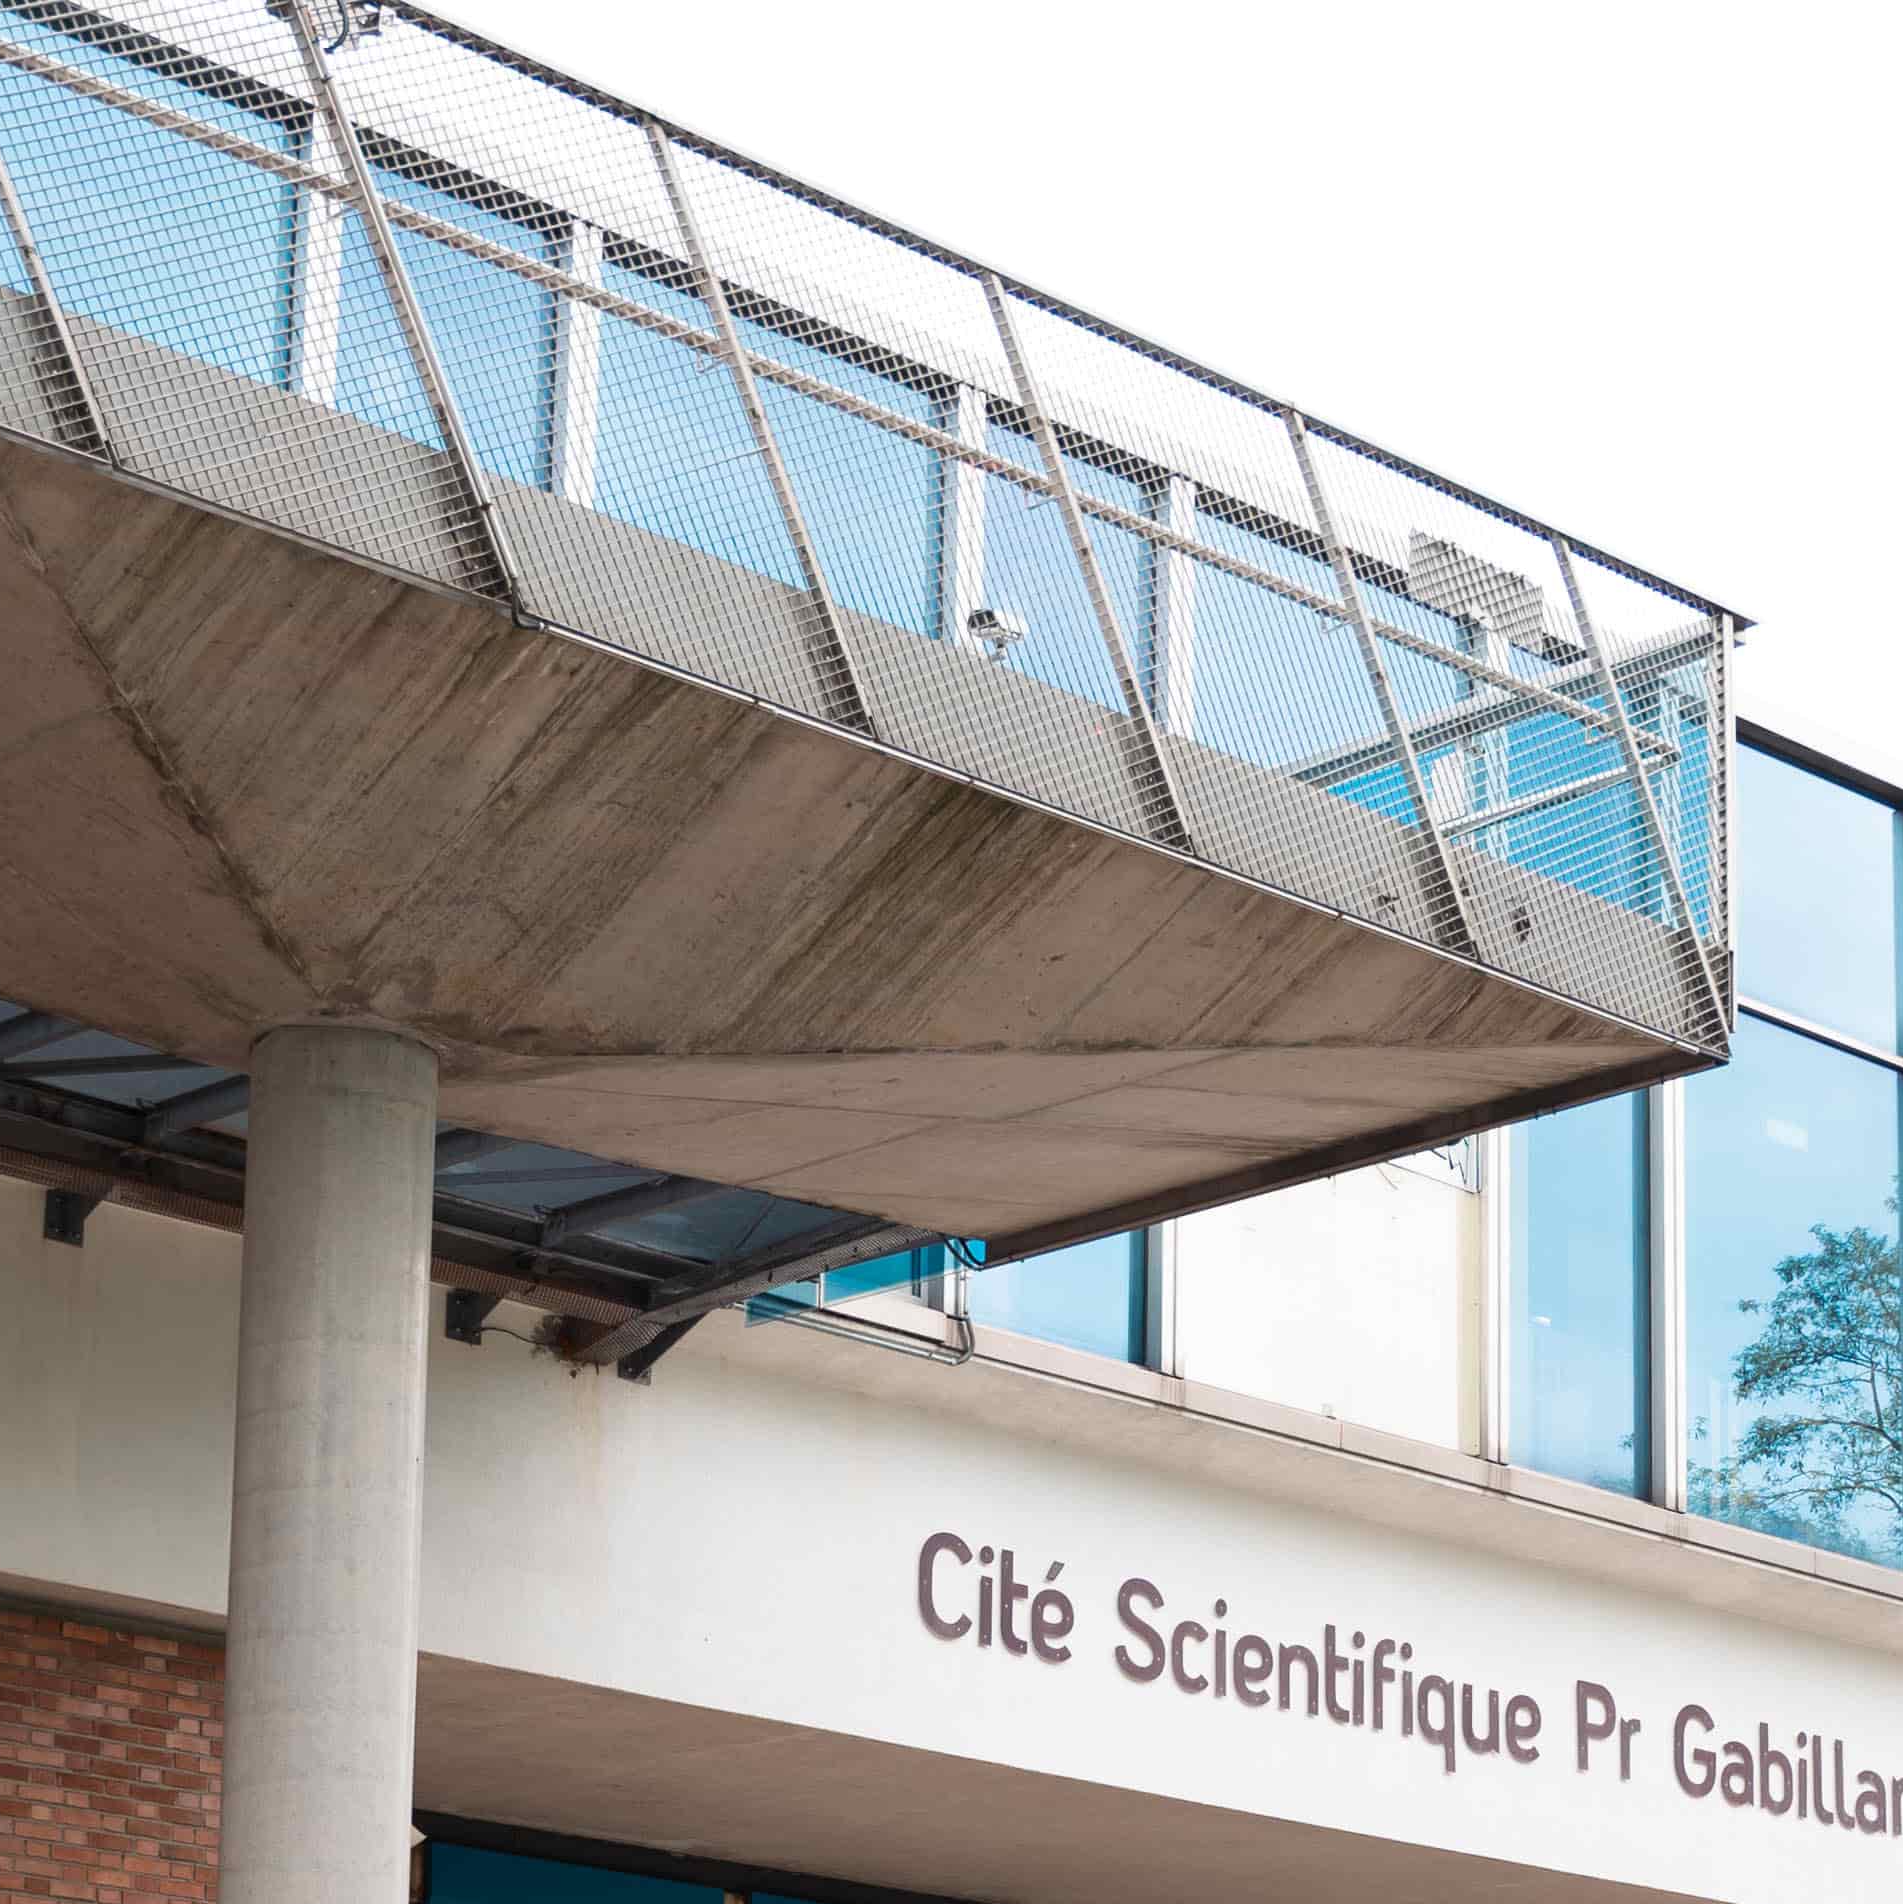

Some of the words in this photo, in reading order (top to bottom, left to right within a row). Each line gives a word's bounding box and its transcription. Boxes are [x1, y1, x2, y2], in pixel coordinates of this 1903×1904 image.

[917, 1531, 1075, 1665] Cité
[1114, 1577, 1542, 1773] Scientifique
[1575, 1679, 1642, 1780] Pr
